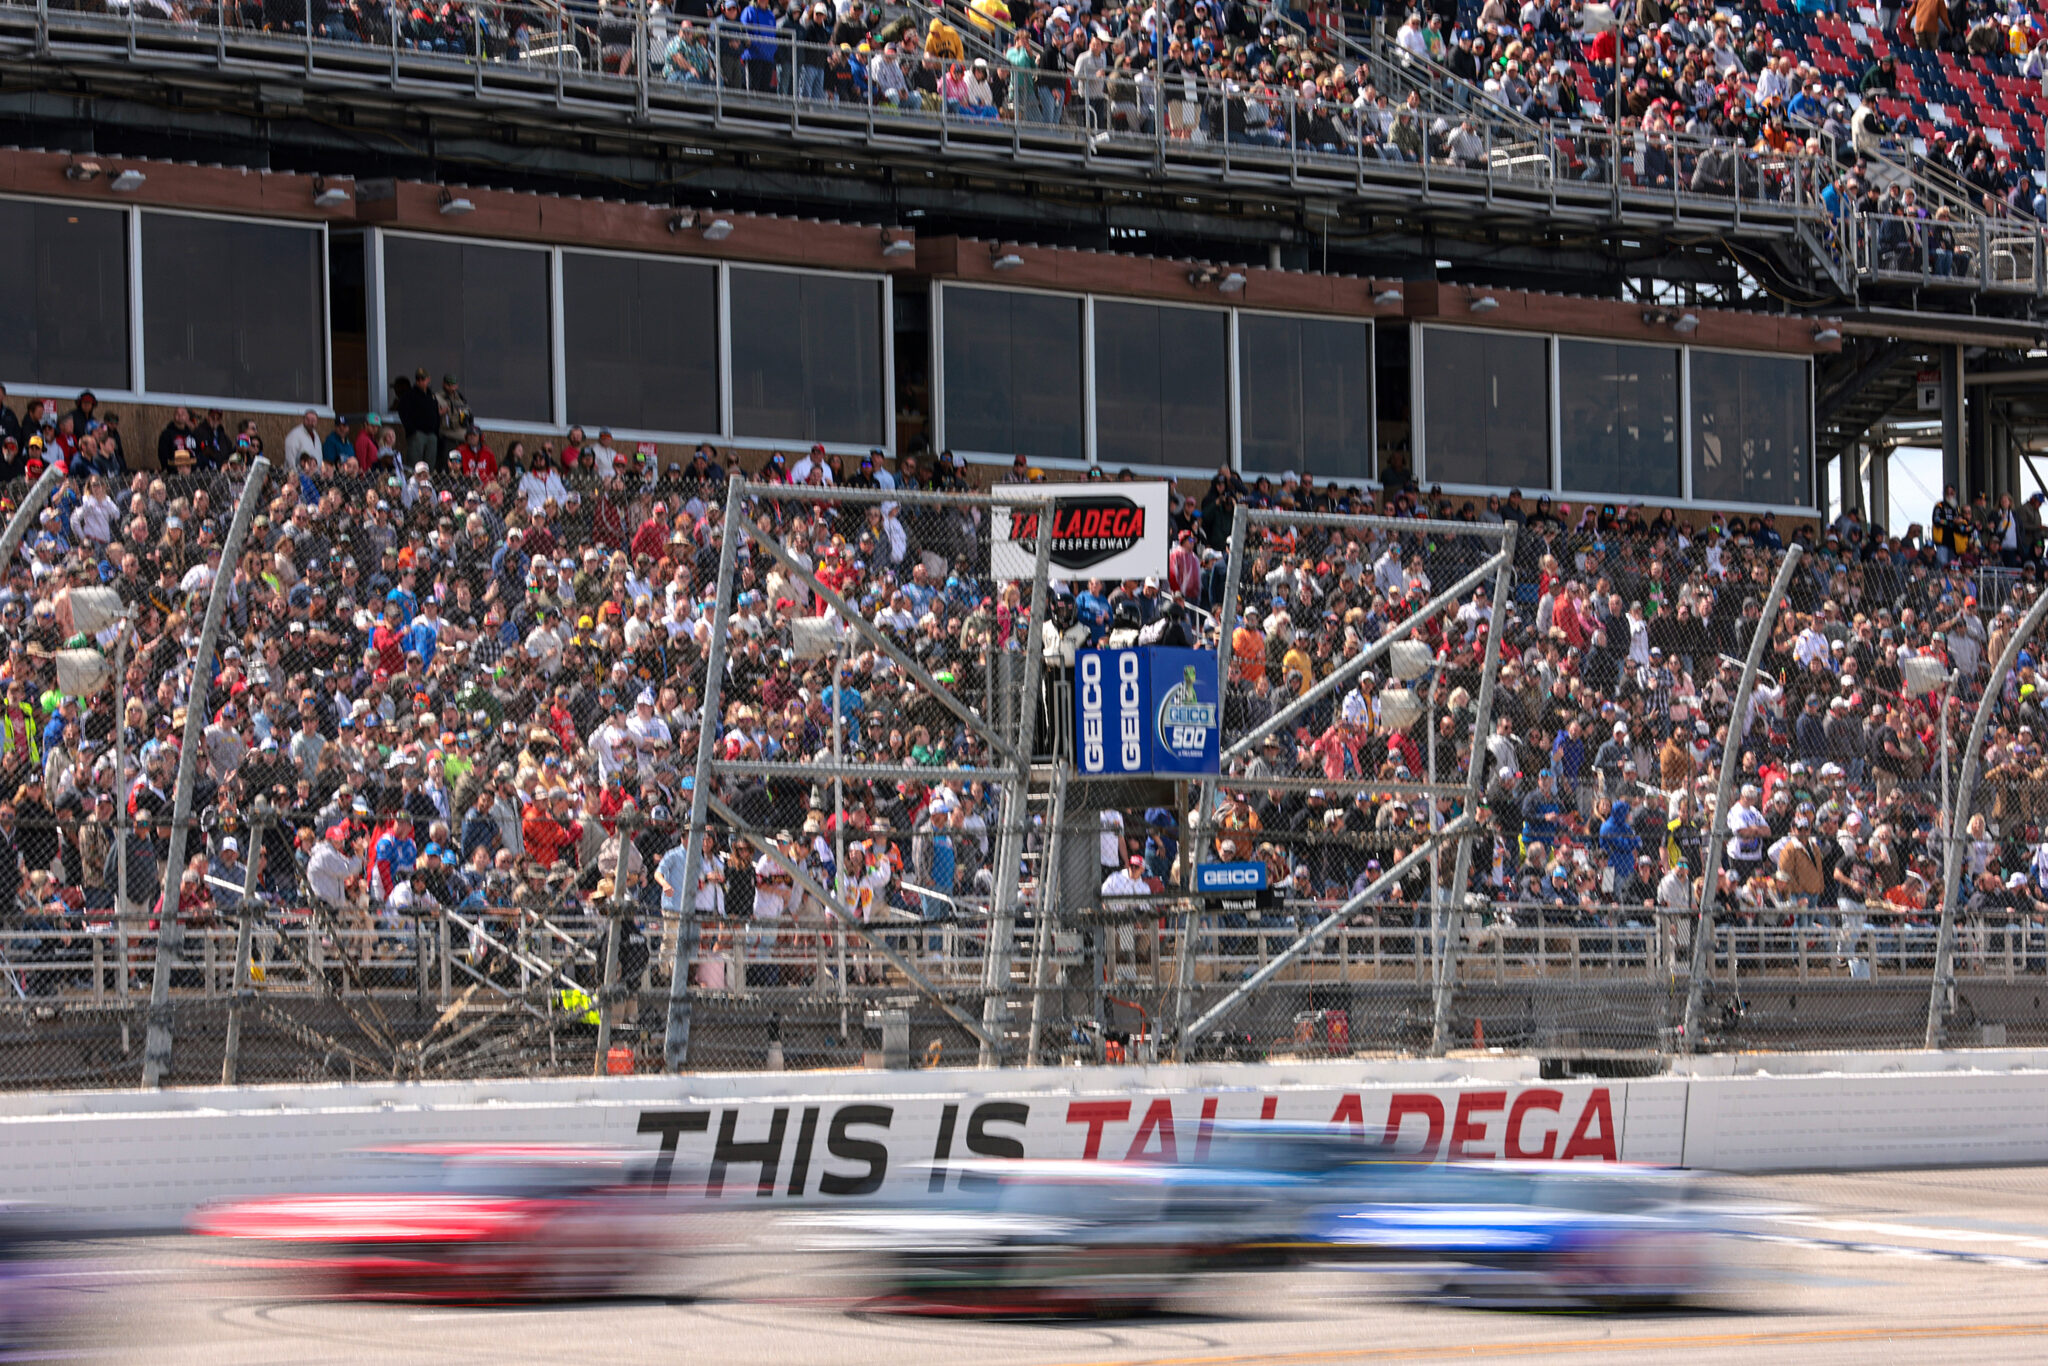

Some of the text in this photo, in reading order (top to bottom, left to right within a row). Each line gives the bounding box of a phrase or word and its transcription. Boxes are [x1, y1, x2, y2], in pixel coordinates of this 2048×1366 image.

[1925, 388, 1935, 405] F
[1011, 508, 1143, 539] TALADEGA
[1027, 538, 1131, 551] ERSPEEDWAY
[1082, 653, 1104, 772] GEICO
[1119, 651, 1141, 771] GEICO
[1170, 707, 1209, 723] GEICO
[1172, 726, 1206, 749] 500
[1204, 869, 1259, 885] GEICO
[637, 1087, 1618, 1198] THIS IS TADEGA
